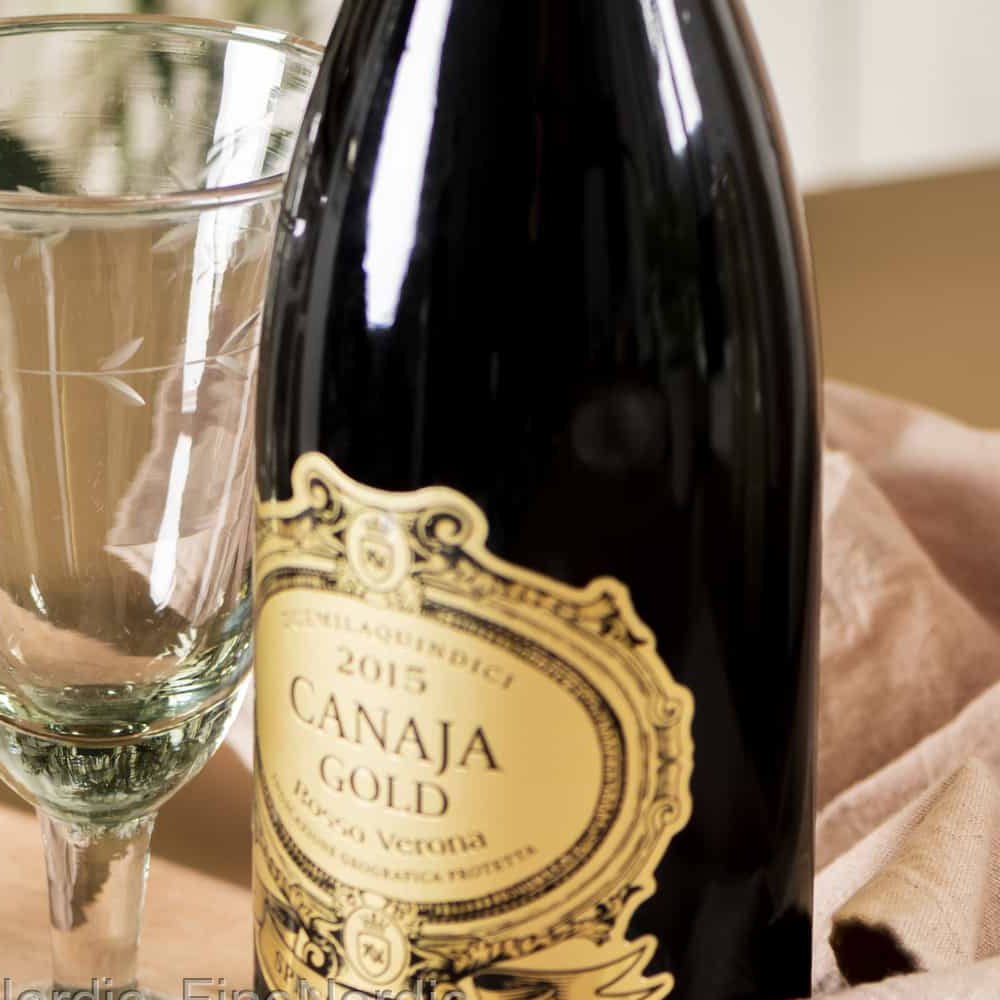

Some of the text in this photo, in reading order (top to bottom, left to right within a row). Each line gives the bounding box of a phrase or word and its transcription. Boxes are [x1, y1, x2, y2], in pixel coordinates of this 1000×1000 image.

[336, 645, 427, 694] 2015
[289, 674, 503, 776] CANAJA
[319, 754, 450, 817] GOLD
[376, 829, 488, 856] Verona
